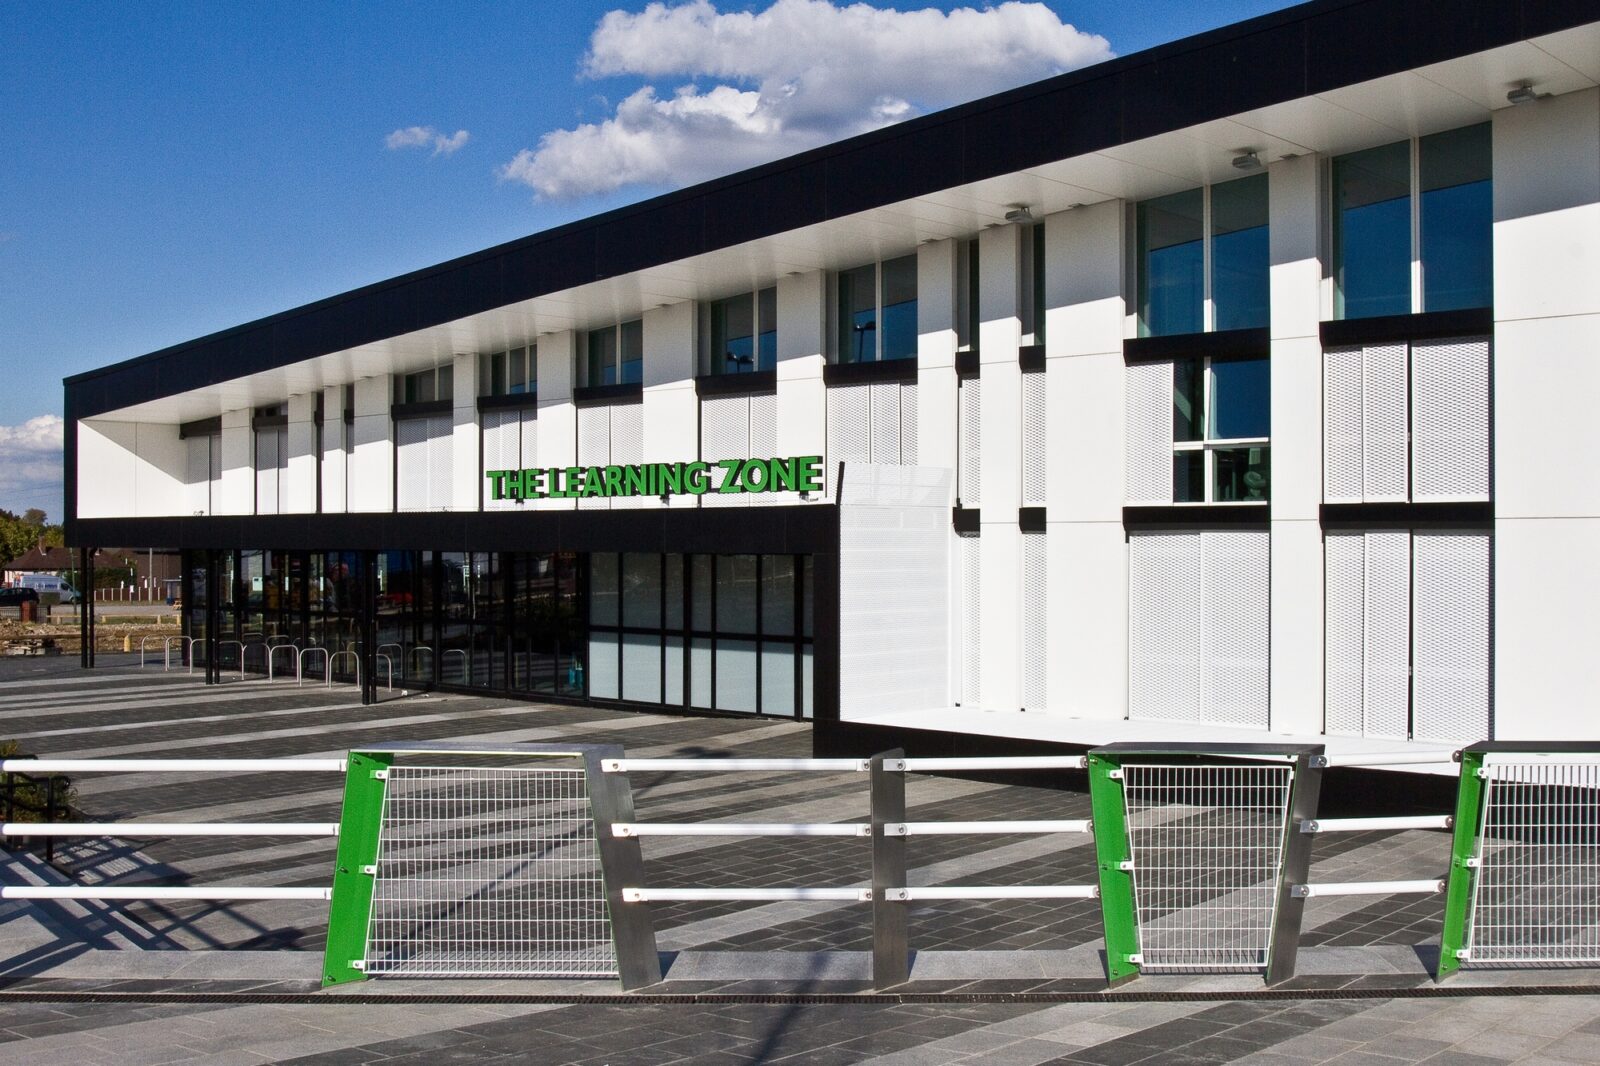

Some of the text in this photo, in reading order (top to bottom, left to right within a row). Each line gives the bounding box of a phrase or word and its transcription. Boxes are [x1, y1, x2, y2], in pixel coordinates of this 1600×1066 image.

[486, 456, 823, 500] THE LEARNING ZONE
